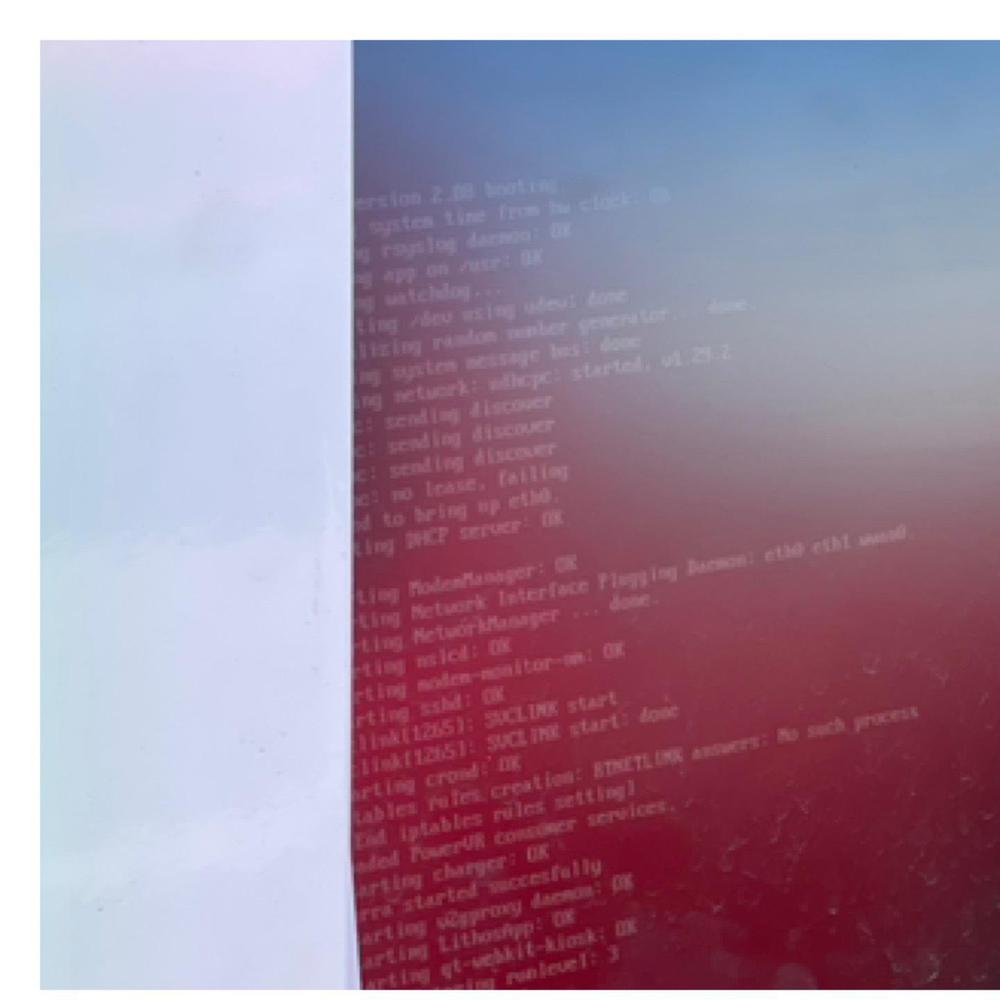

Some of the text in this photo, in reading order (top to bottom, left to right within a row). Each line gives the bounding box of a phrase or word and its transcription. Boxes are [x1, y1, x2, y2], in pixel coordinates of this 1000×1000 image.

[550, 221, 573, 239] OK
[520, 248, 545, 268] OK
[462, 303, 516, 322] using
[586, 288, 630, 307] done
[432, 328, 498, 351] random
[506, 319, 568, 341] number
[392, 360, 459, 384] system
[465, 349, 540, 370] message
[600, 335, 643, 352] done
[384, 406, 461, 431] sending
[469, 396, 552, 419] discover
[386, 430, 462, 456] sending
[472, 420, 556, 443] discover
[389, 455, 464, 480] sending
[474, 443, 558, 467] discover
[391, 486, 415, 503] no
[498, 462, 570, 488] failing
[383, 511, 406, 529] to
[414, 502, 468, 525] bring
[477, 498, 501, 518] up
[405, 526, 450, 550] DHCP
[541, 509, 565, 528] OK
[553, 553, 579, 574] OK
[357, 610, 401, 631] ting
[411, 592, 487, 621] Network
[499, 580, 591, 608] Interface
[597, 565, 679, 592] Plugging
[413, 607, 561, 645] NetworkManager
[488, 635, 513, 657] OK
[602, 639, 627, 661] OK
[481, 684, 506, 706] OK
[566, 689, 618, 715] start
[638, 704, 682, 725] done
[776, 726, 800, 745] No
[807, 715, 847, 739] such
[852, 704, 920, 735] process
[498, 755, 523, 773] OK
[400, 813, 484, 843] iptables
[492, 800, 547, 824] rules
[493, 819, 578, 846] consumer
[526, 843, 550, 864] OK
[611, 871, 636, 893] OK
[402, 880, 479, 914] started
[551, 907, 578, 928] OK
[614, 916, 639, 938] OK
